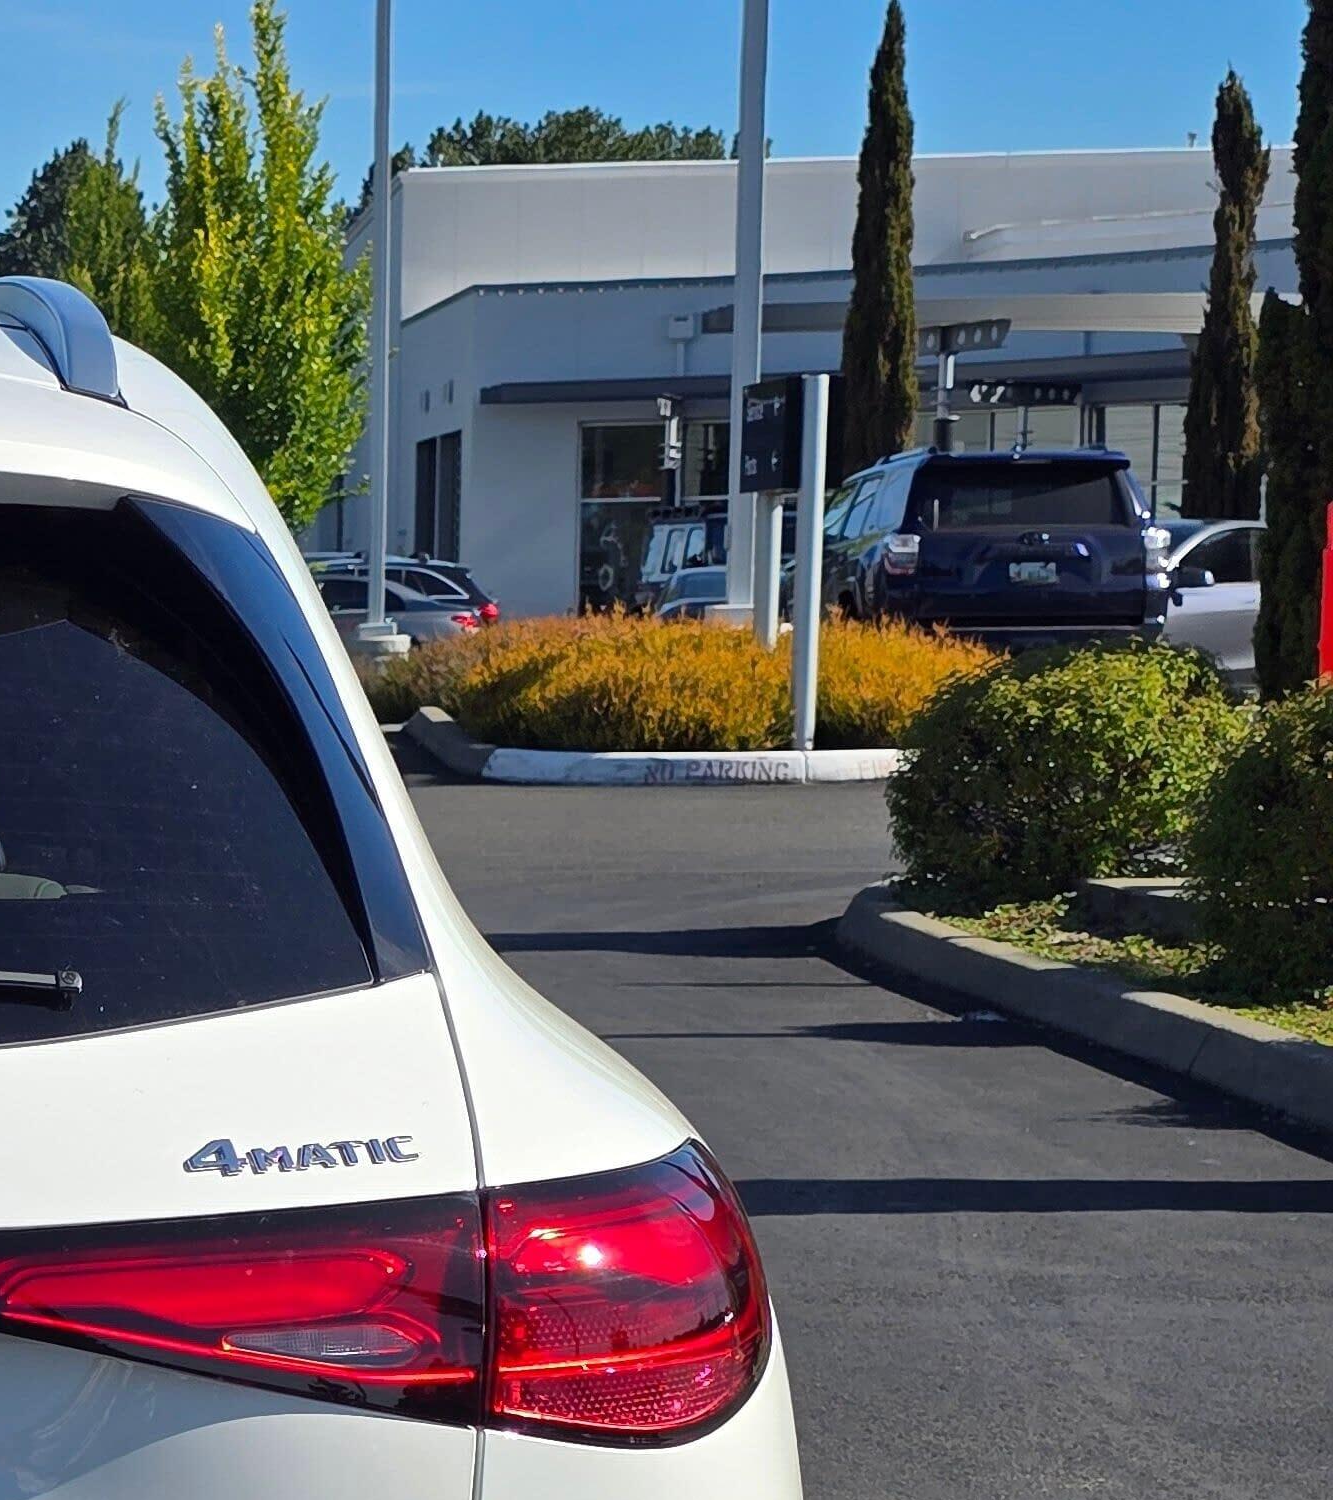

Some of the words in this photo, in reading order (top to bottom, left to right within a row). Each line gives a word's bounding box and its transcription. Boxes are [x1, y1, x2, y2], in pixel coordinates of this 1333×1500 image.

[644, 761, 674, 784] NO
[685, 760, 790, 783] PARKING
[183, 1136, 419, 1177] 4MATIC
